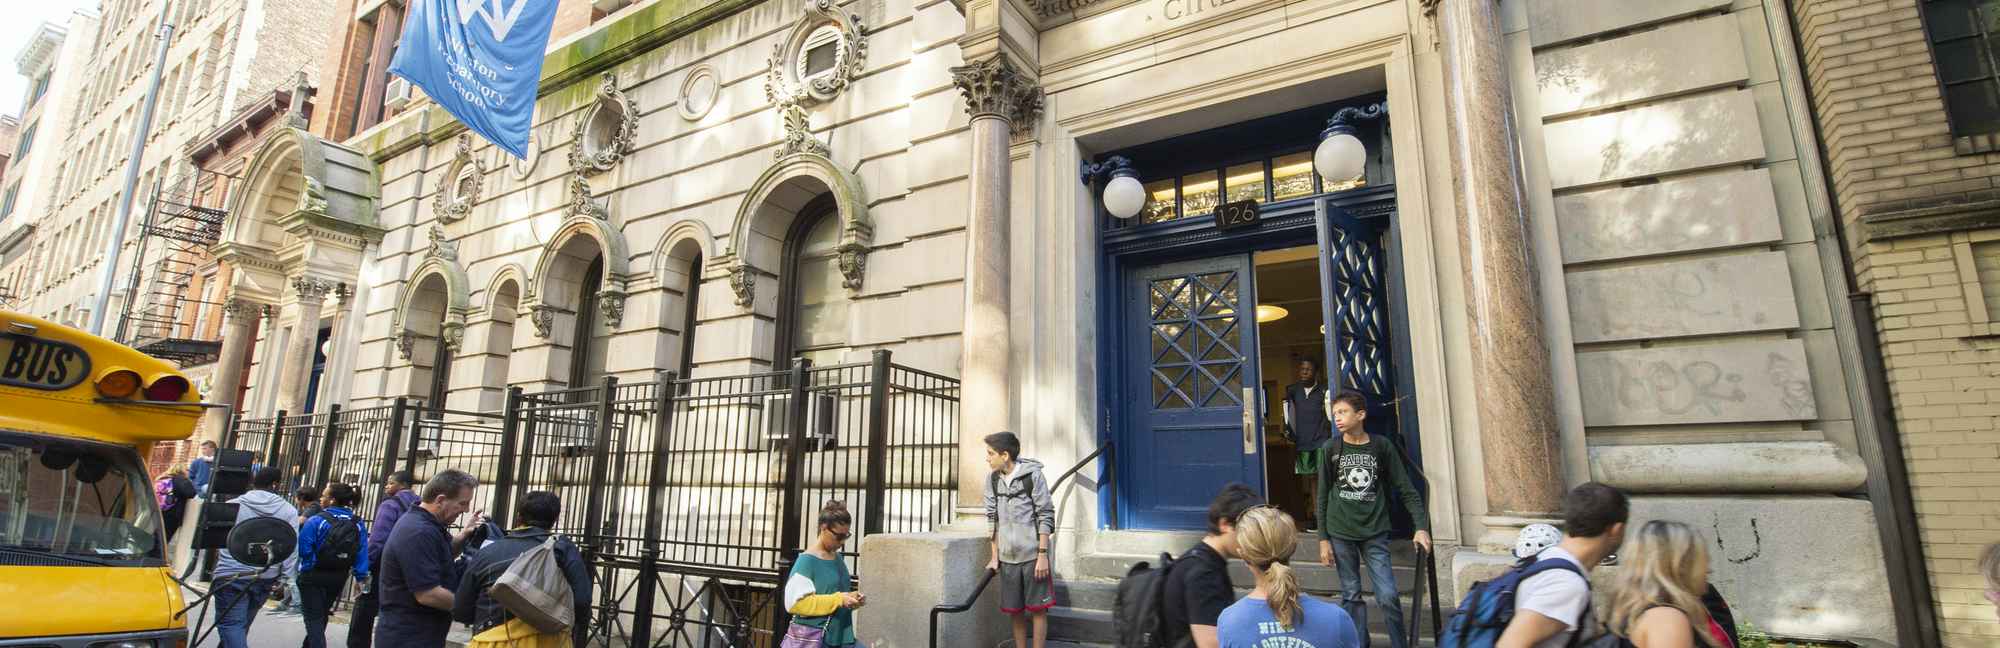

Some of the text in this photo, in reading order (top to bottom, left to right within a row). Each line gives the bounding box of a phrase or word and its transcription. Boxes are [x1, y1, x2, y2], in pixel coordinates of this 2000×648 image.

[452, 38, 497, 81] Wston
[1220, 203, 1255, 225] 126
[2, 340, 74, 385] BUS
[1340, 453, 1378, 467] CADEM
